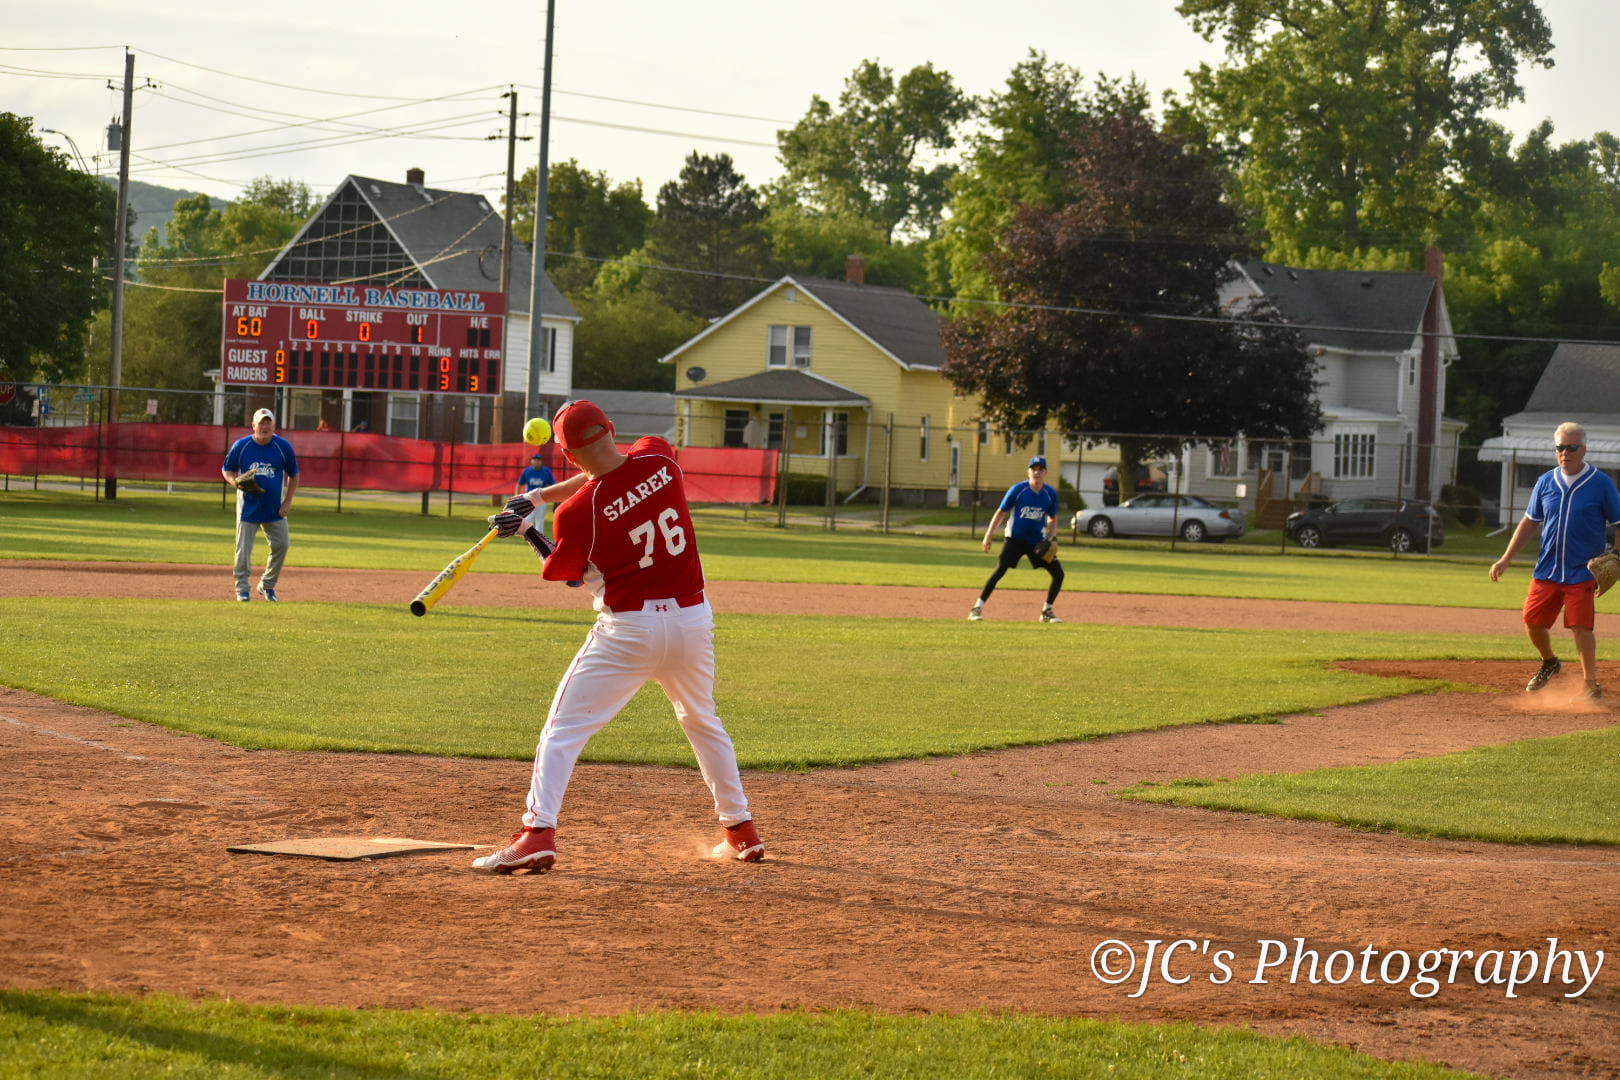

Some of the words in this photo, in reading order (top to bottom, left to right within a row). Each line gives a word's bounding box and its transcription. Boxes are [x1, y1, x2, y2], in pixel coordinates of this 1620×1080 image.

[247, 282, 360, 305] HORNELL
[364, 288, 485, 311] BASEBALL
[232, 305, 246, 317] AT
[248, 305, 268, 318] BAT
[299, 308, 326, 321] BALL
[346, 310, 383, 323] STRIKE
[406, 313, 428, 326] OUT
[237, 317, 262, 336] 60
[307, 320, 318, 339] 0
[470, 316, 488, 328] H/E
[359, 322, 370, 341] 0
[417, 325, 423, 343] 1
[228, 348, 268, 364] GUEST
[275, 349, 285, 365] 0
[291, 342, 298, 351] 2
[322, 342, 329, 351] 4
[411, 346, 421, 356] 10
[428, 346, 452, 357] RUNS
[459, 349, 479, 359] HITS
[484, 349, 501, 360] ERR
[440, 356, 450, 373] 0
[227, 366, 268, 381] RAIDERS
[275, 366, 285, 383] 3
[440, 374, 450, 390] 3
[470, 375, 479, 392] 3
[602, 465, 673, 522] SZAREK
[628, 507, 687, 569] 76
